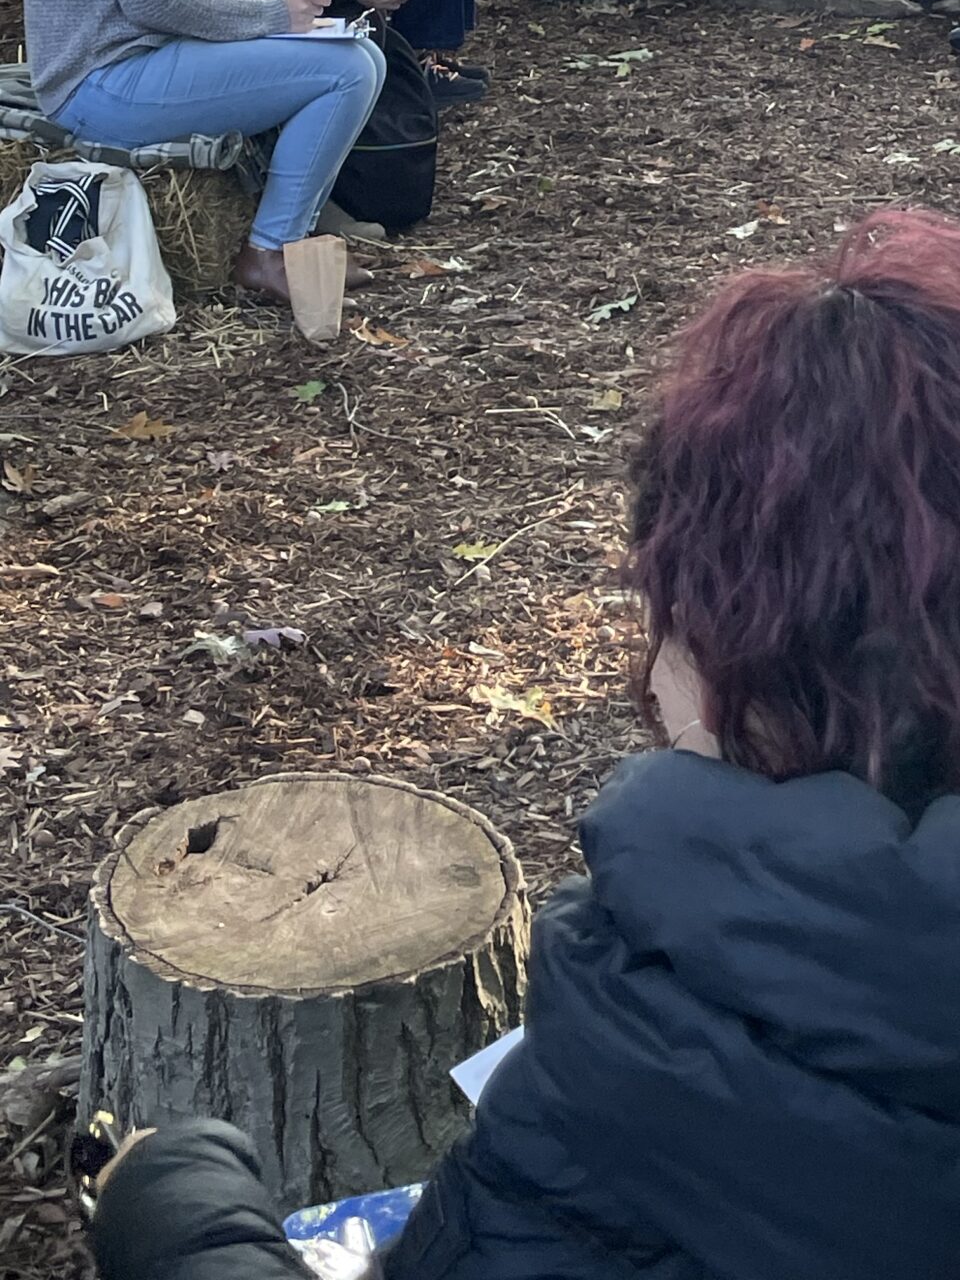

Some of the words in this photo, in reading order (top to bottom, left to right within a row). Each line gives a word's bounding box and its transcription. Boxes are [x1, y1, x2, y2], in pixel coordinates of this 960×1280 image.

[27, 308, 47, 338] IN
[51, 312, 97, 341] THE
[98, 292, 144, 334] CAR
